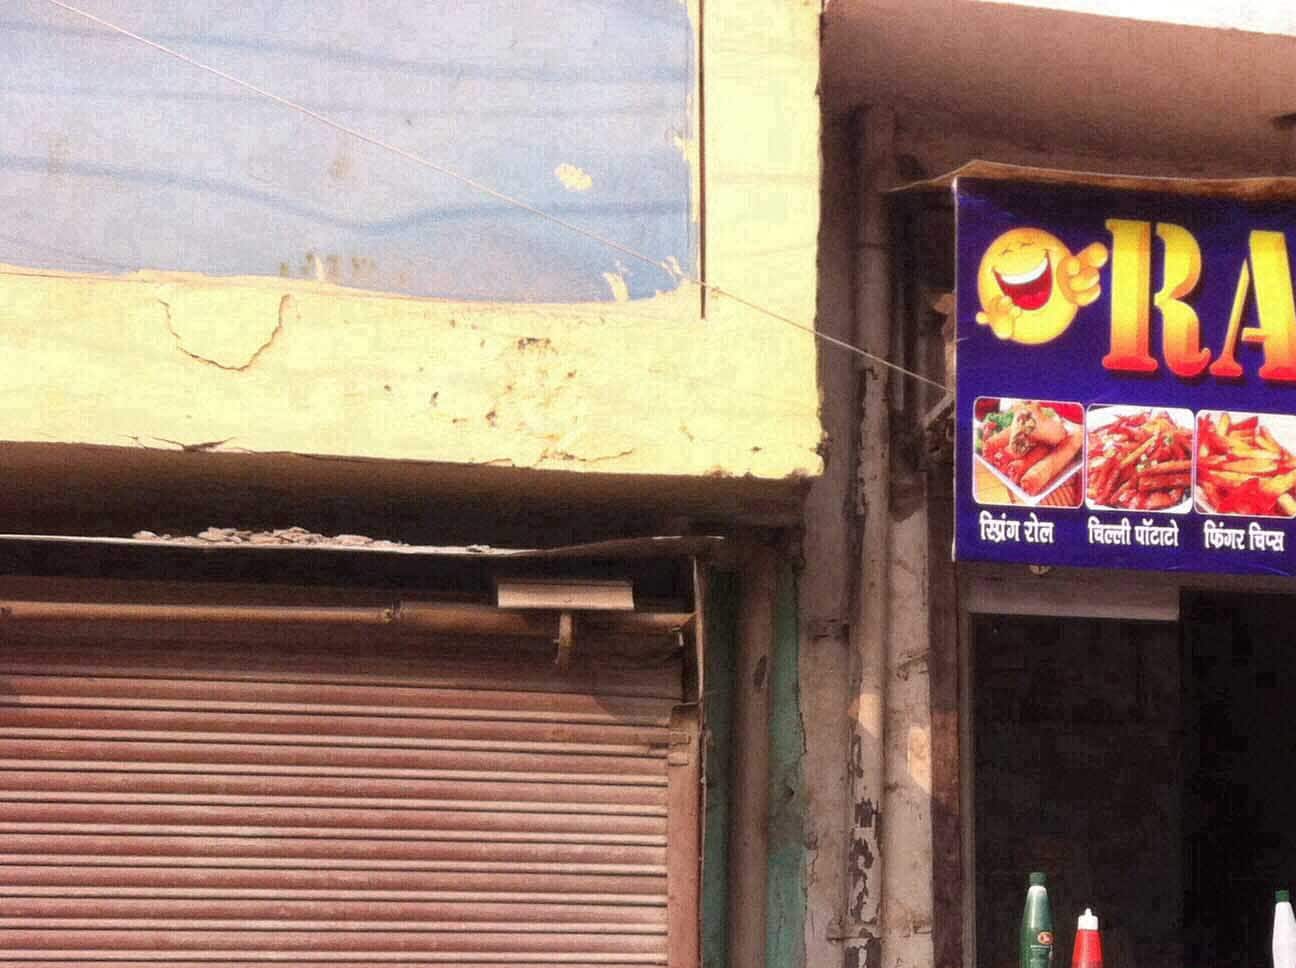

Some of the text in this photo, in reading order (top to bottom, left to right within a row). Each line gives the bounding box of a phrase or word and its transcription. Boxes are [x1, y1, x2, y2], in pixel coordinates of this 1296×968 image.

[1024, 512, 1055, 543] रोल
[1087, 516, 1131, 545] चिल्ली
[1135, 517, 1179, 547] पॉटाटो
[1203, 520, 1245, 550] फिंगर
[1249, 522, 1285, 551] चिप्स
